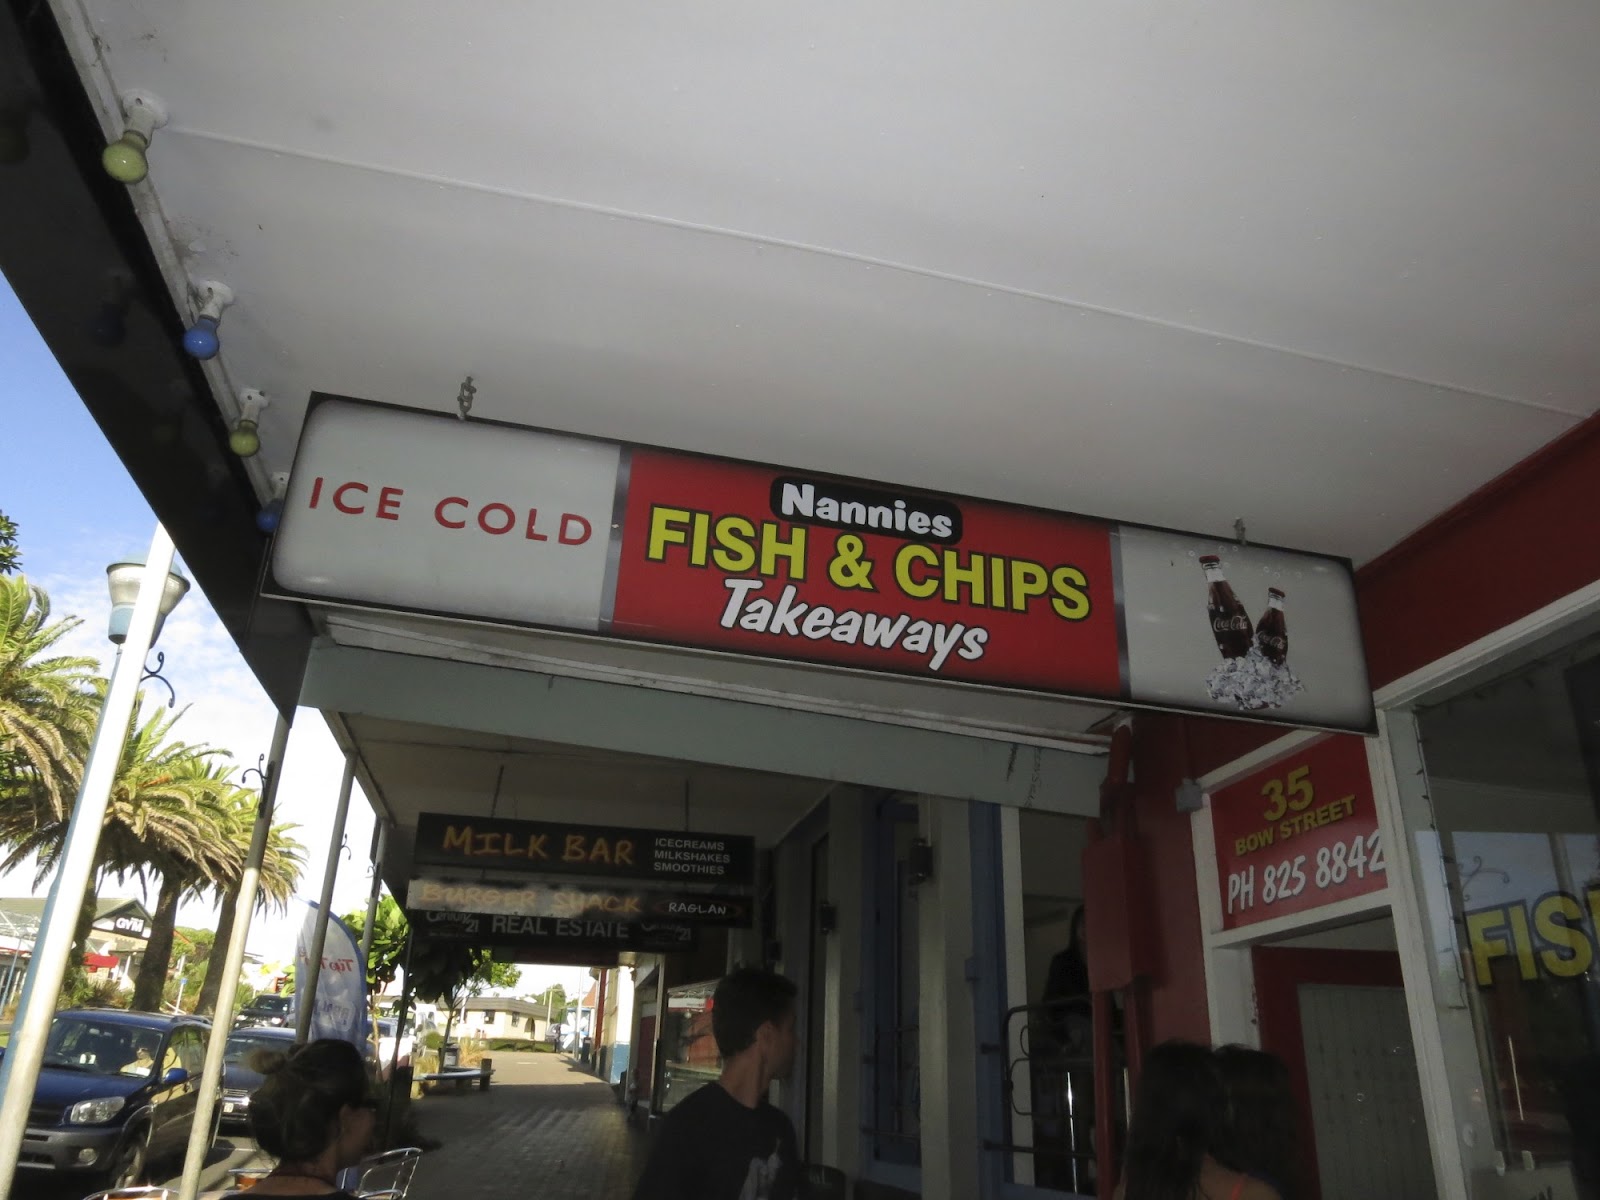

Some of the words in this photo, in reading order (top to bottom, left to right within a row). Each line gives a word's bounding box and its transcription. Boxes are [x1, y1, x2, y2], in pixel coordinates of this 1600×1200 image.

[309, 477, 404, 520] ICE
[434, 496, 593, 546] COLD
[780, 482, 953, 538] Nannies
[647, 506, 808, 579] FISH
[828, 533, 875, 590] &
[894, 543, 1090, 620] CHIPS
[720, 578, 989, 671] Takeaways
[1260, 765, 1315, 822] 35
[442, 825, 548, 858] MILK
[562, 835, 634, 865] BAR
[655, 837, 726, 851] ICECREAMS
[1235, 828, 1275, 857] BOW
[1279, 794, 1357, 841] STREET
[654, 850, 731, 864] MILKSHAKES
[654, 862, 725, 875] SMOOTHIES
[1228, 865, 1254, 915] PH
[1262, 855, 1307, 905] 825
[1315, 828, 1388, 888] 8842
[116, 917, 144, 933] GYM
[491, 915, 548, 935] REAL
[556, 919, 630, 938] ESTATE
[668, 902, 727, 915] RAGLAN
[1466, 889, 1600, 987] FIS
